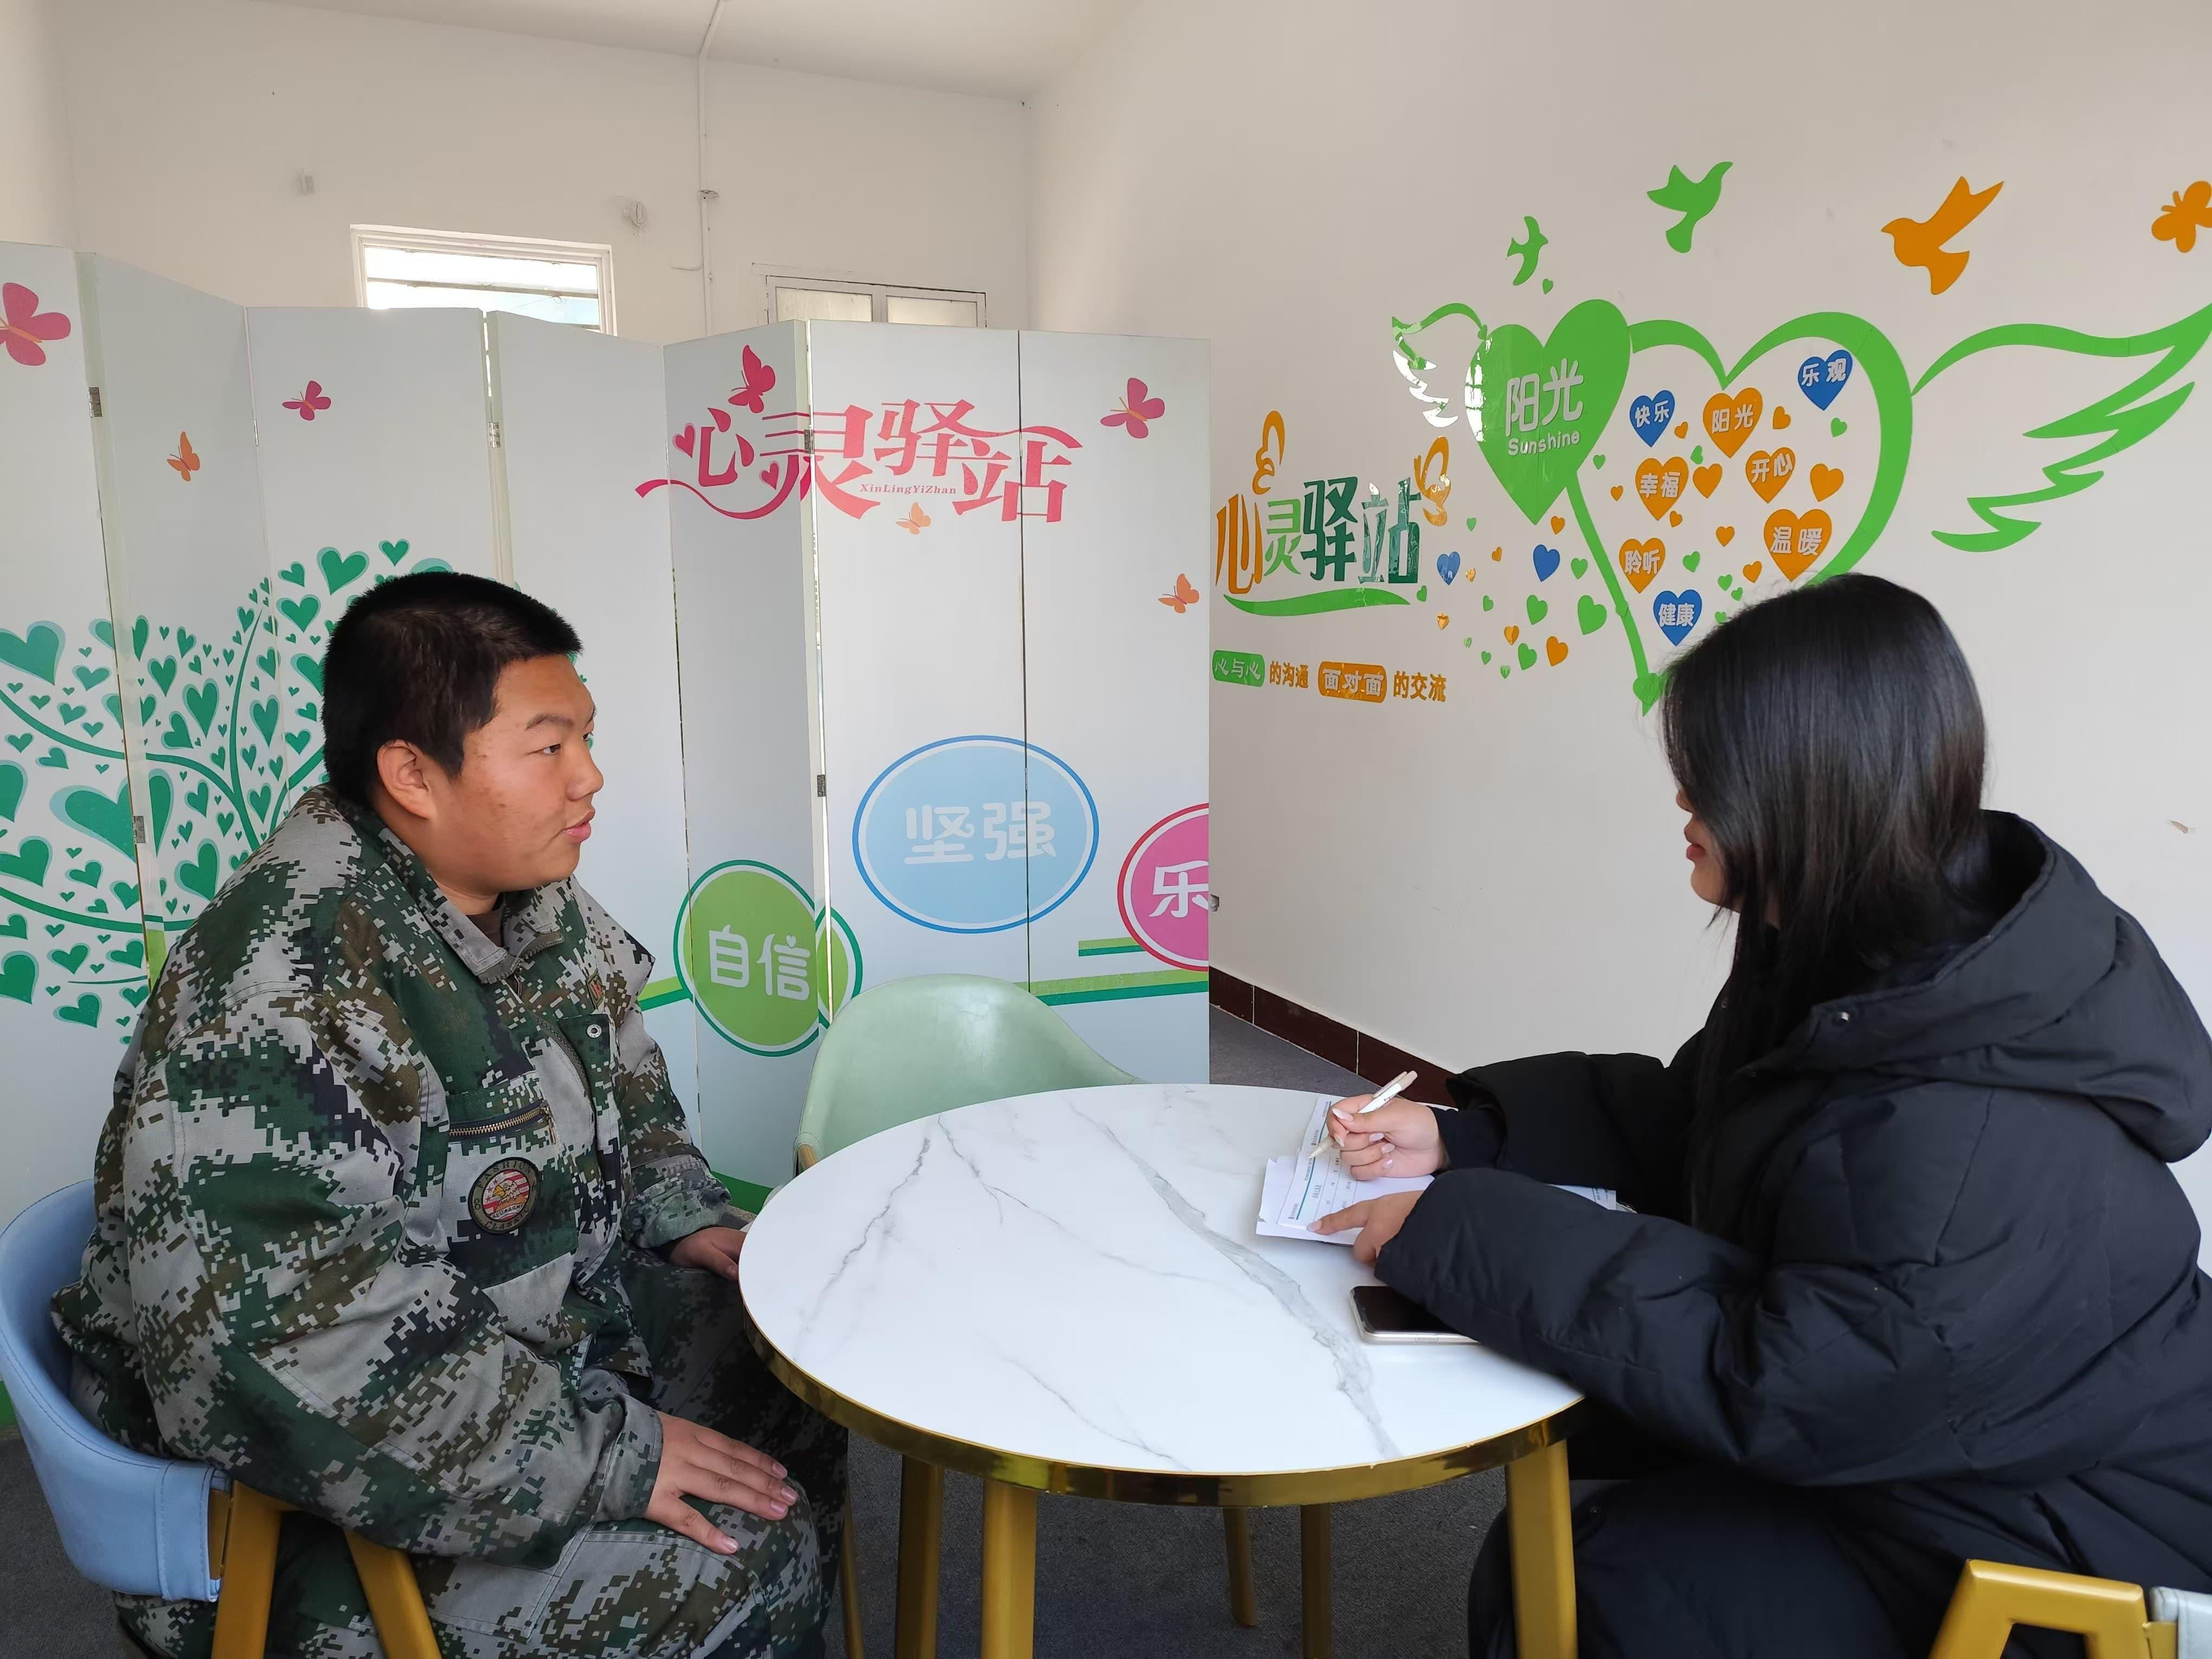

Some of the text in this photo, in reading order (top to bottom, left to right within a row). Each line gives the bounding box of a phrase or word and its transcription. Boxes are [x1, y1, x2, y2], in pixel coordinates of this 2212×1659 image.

[1801, 357, 1848, 388] 乐观
[1504, 357, 1584, 437] 阳光
[1635, 400, 1670, 428] 快乐
[1711, 403, 1754, 434] 阳光
[1508, 429, 1580, 456] Sunshine
[635, 398, 1083, 523] 心灵驿站
[1751, 452, 1794, 484] 开心
[859, 483, 957, 495] XinLingYiZhan
[1639, 470, 1681, 499] 幸福
[1215, 476, 1422, 594] 心灵驿站
[1769, 525, 1823, 557] 温暖
[1624, 548, 1661, 576] 聆听
[1658, 602, 1695, 628] 健康
[1269, 660, 1309, 689] 的沟通
[1322, 667, 1384, 697] 面对面
[1393, 670, 1447, 702] 的交流
[903, 801, 1057, 866] 坚强
[1149, 860, 1209, 919] 乐
[708, 923, 812, 1002] 自信
